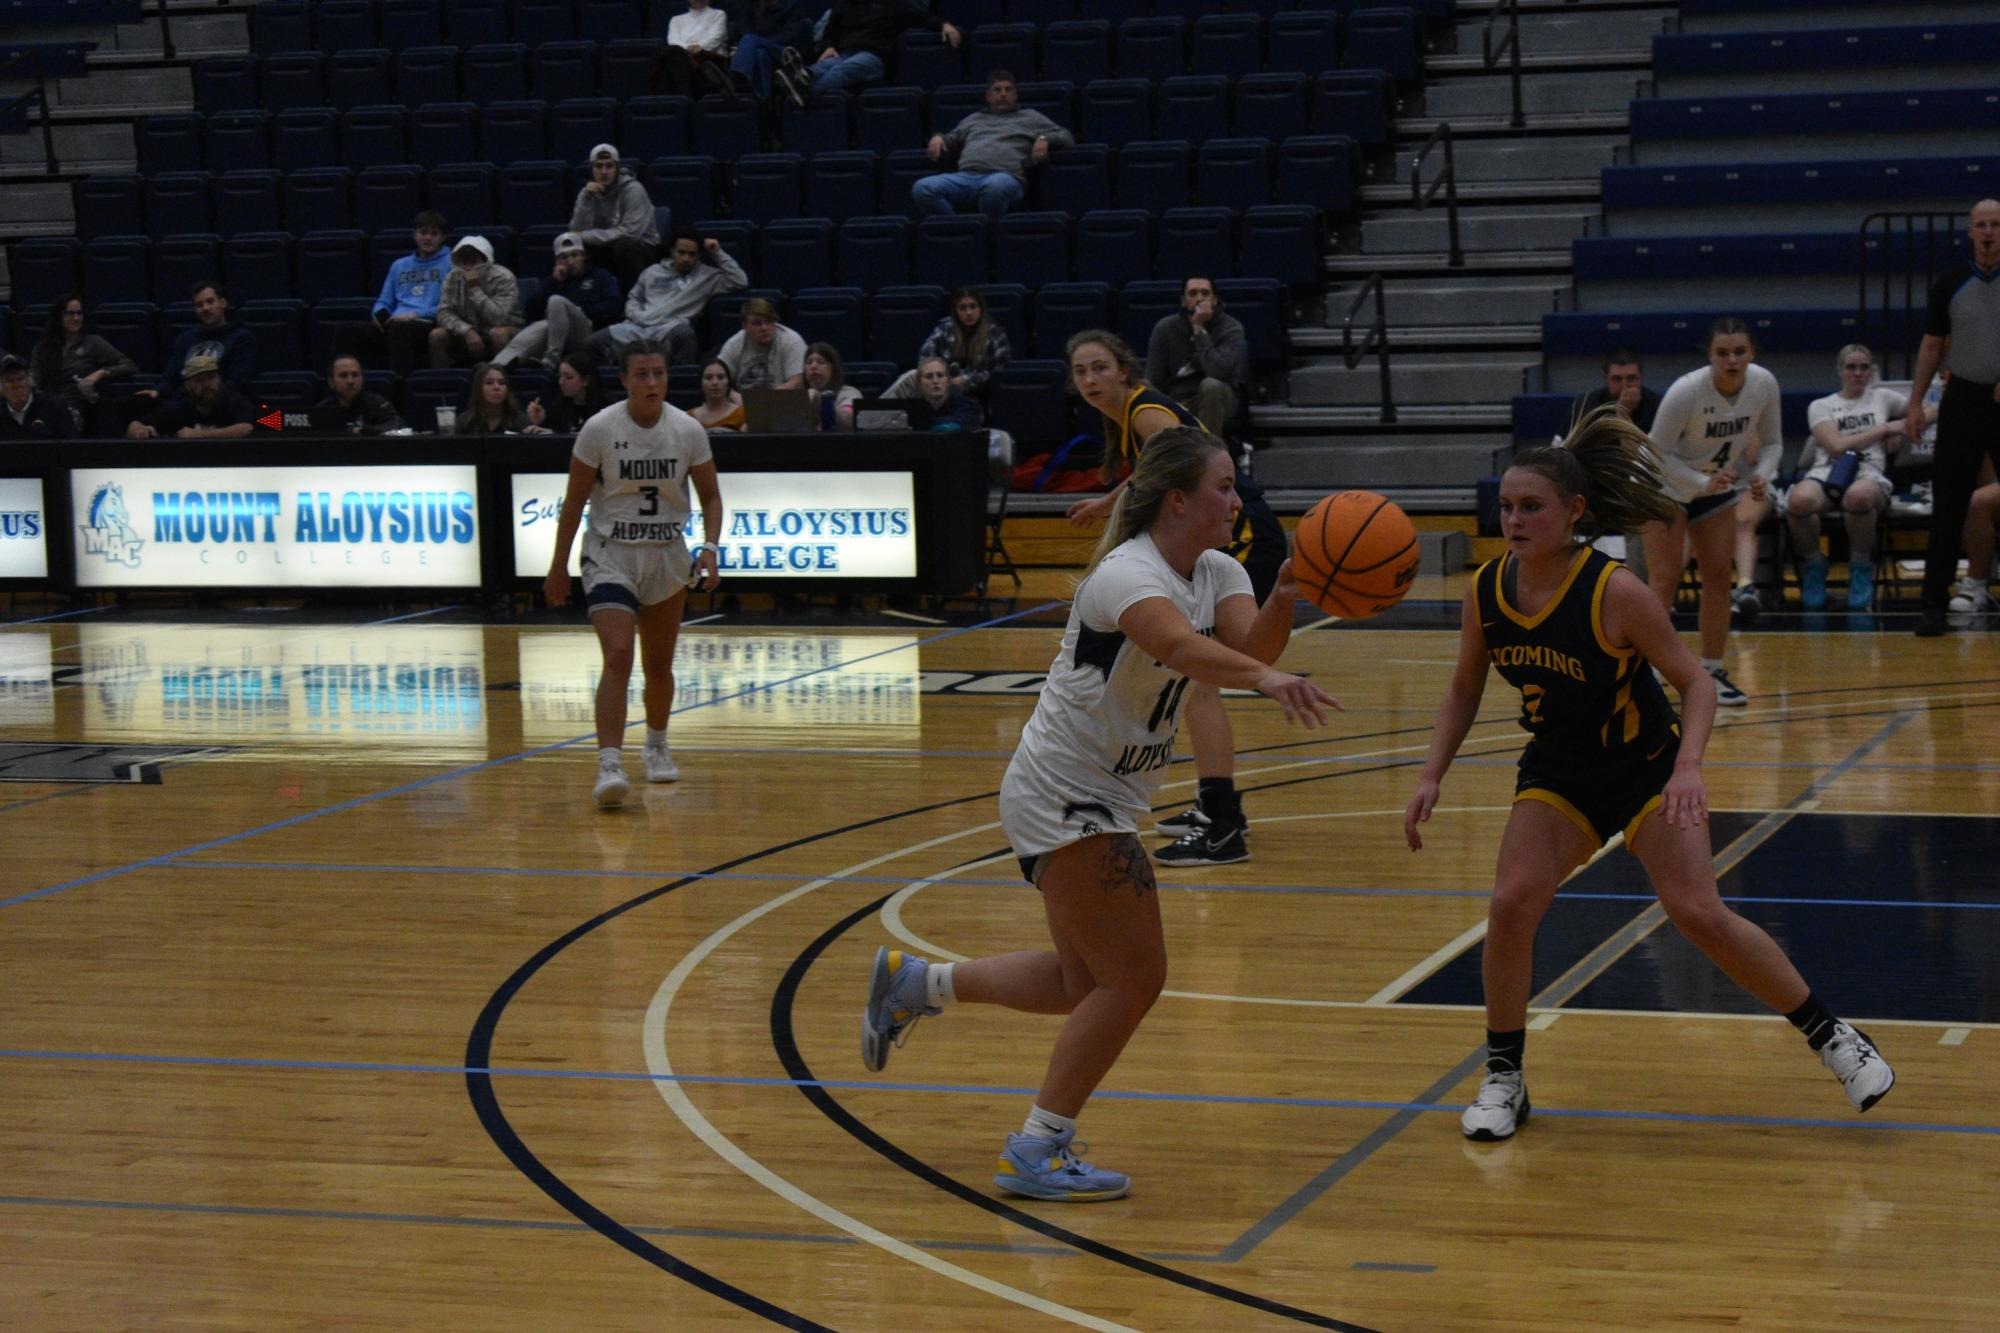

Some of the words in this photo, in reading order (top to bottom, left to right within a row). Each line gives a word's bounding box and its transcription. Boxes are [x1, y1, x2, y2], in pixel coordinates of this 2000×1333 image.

[1711, 442, 1732, 468] 4
[619, 459, 677, 480] MOUNT
[638, 486, 659, 516] 3
[152, 492, 280, 543] MOUNT
[295, 491, 474, 543] ALOYSIUS
[611, 522, 682, 540] ALOYSIUS
[731, 509, 909, 537] ALOYSIUS
[79, 525, 146, 568] MAC
[201, 550, 427, 565] COLLEGE
[1148, 676, 1191, 733] 14
